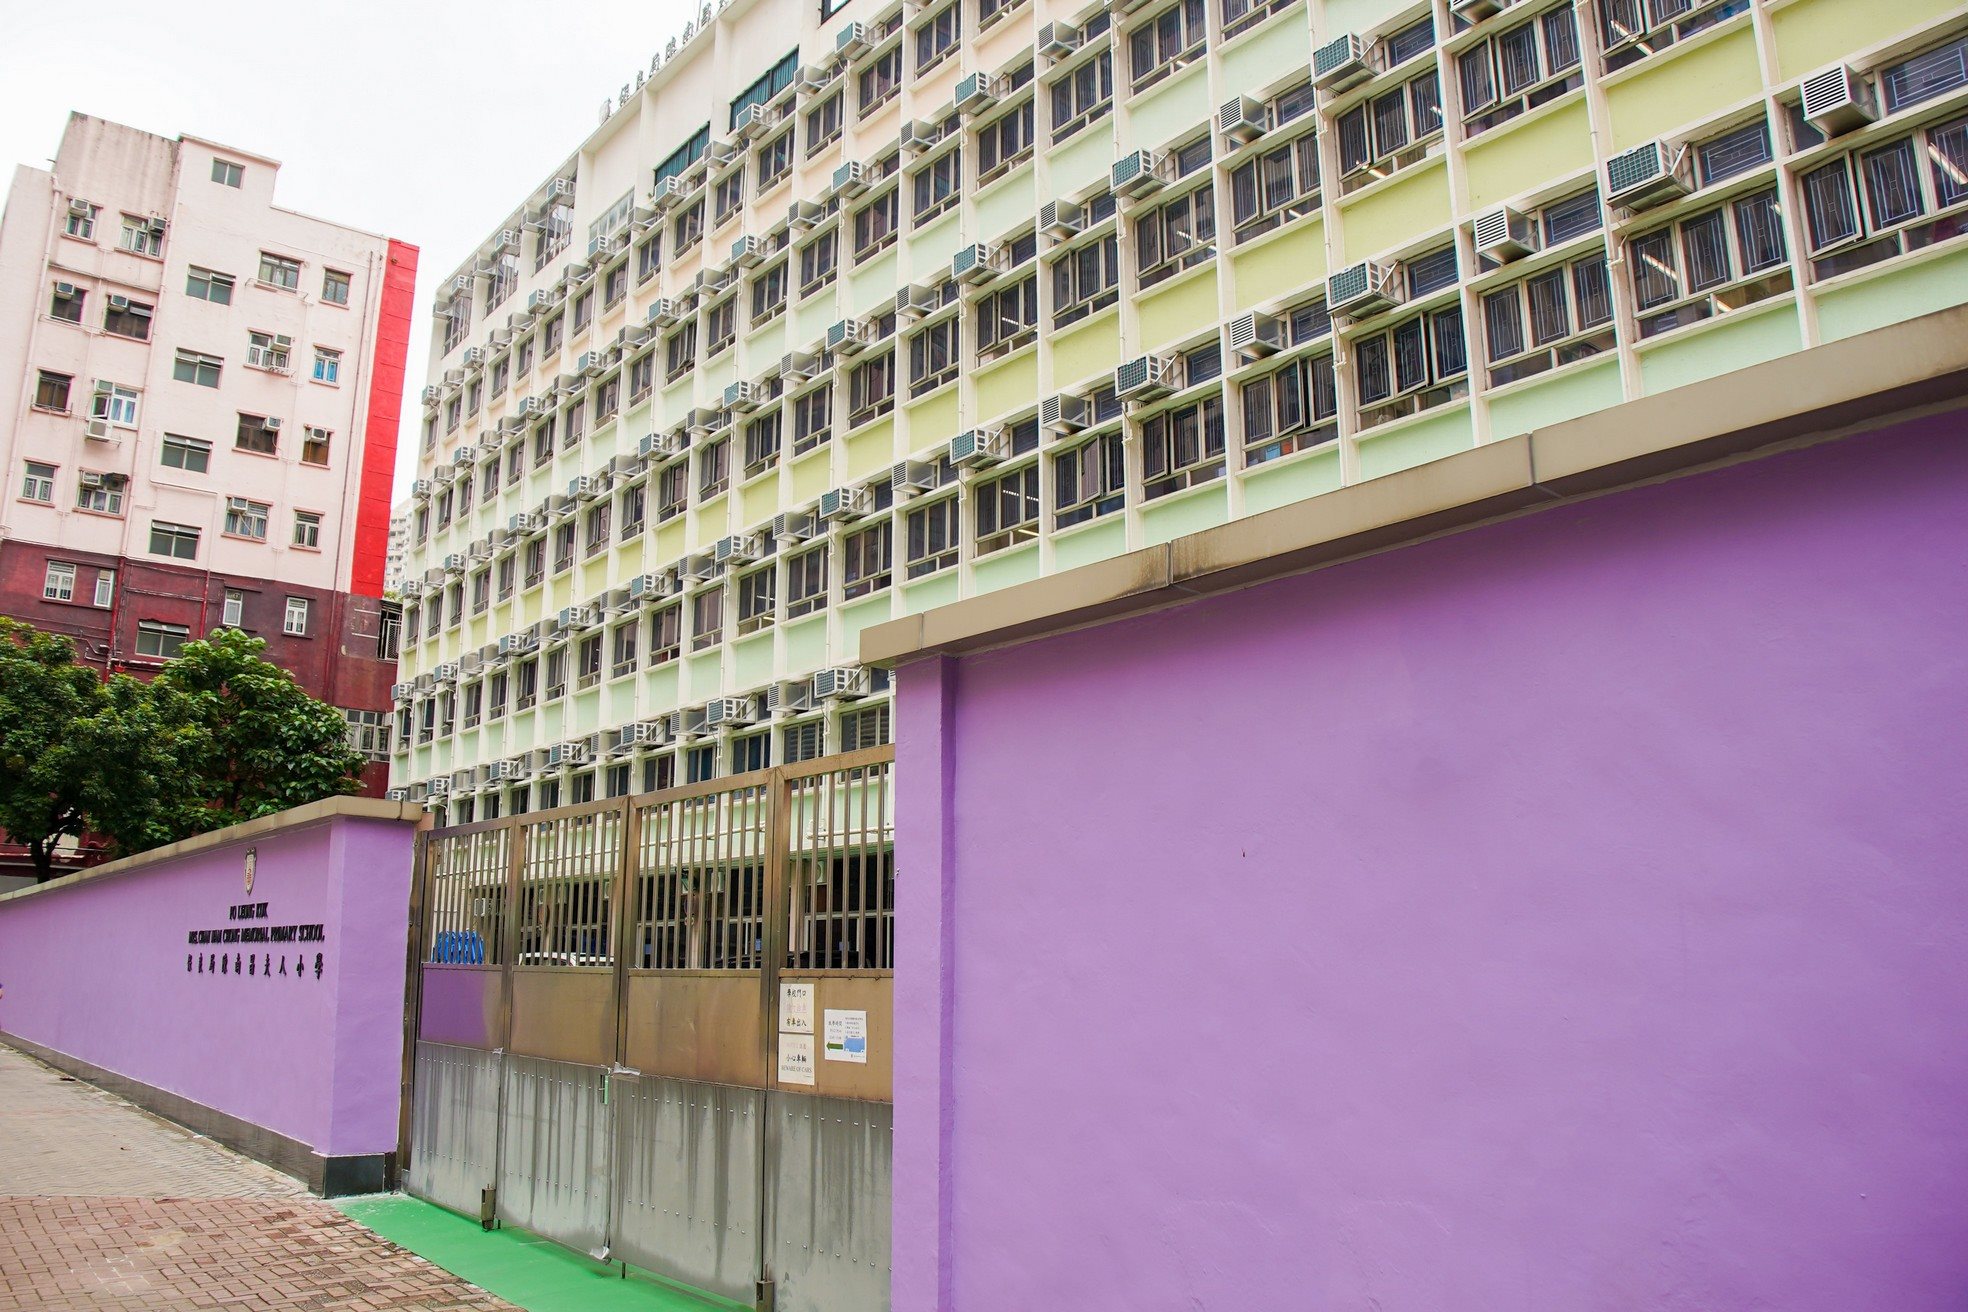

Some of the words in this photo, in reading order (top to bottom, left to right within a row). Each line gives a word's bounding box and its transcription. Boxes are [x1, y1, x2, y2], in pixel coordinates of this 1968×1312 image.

[229, 905, 237, 920] PO
[238, 903, 255, 920] LEUNG
[256, 902, 269, 919] KUK
[223, 928, 240, 943] CHONG
[241, 926, 270, 942] MEMORIAL
[270, 925, 298, 942] PRIMARY
[298, 924, 325, 941] SCHOOL
